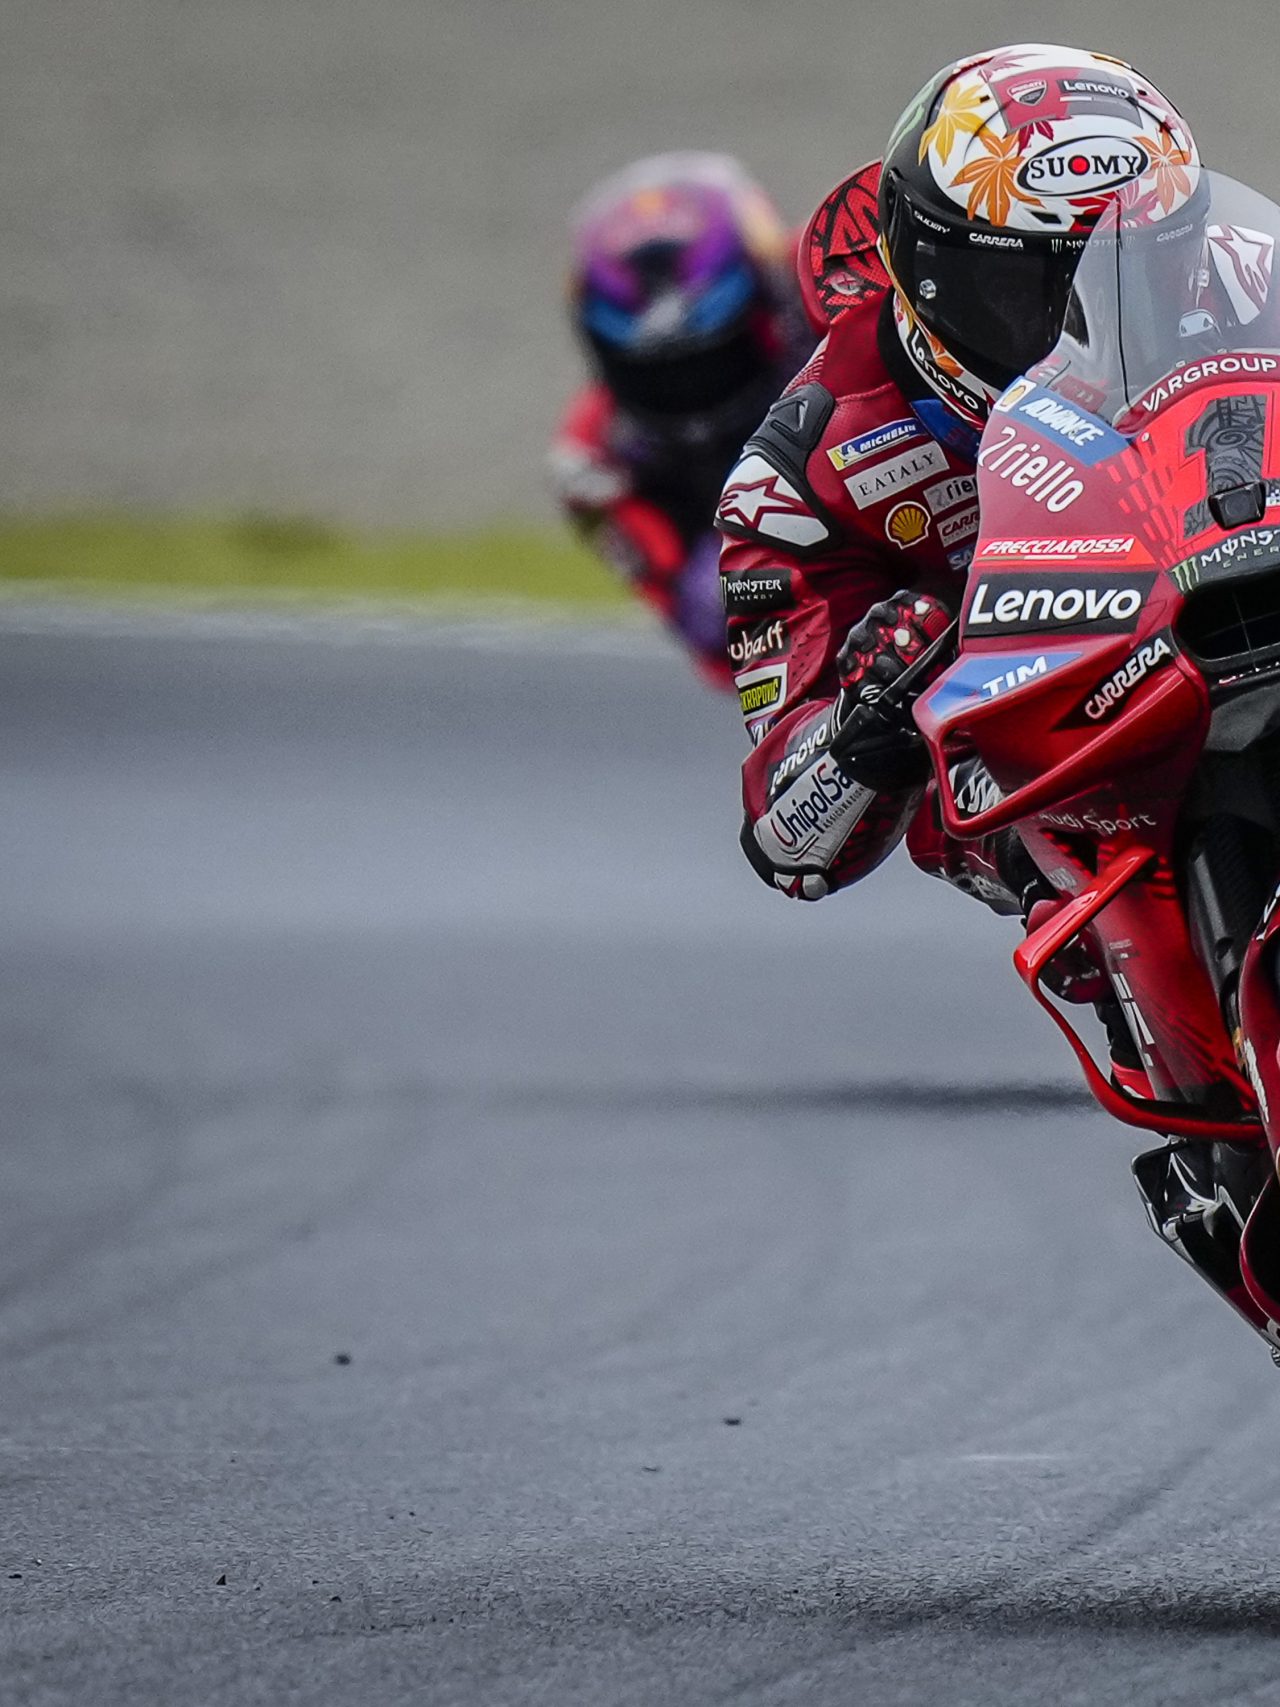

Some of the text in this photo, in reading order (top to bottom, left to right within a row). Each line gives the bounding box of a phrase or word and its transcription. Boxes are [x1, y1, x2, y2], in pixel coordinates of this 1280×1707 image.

[1063, 80, 1129, 98] Lenovo
[1030, 154, 1140, 180] SUOMY
[969, 232, 1024, 248] CARRERA
[911, 329, 979, 409] Lenovo
[859, 423, 916, 453] MICHELIN
[857, 452, 934, 496] EATALY
[941, 510, 979, 537] CARR
[981, 538, 1135, 555] FRECCIAROSSA
[727, 579, 782, 595] MONSTER
[967, 584, 1143, 625] Lenovo
[979, 656, 1048, 700] TIM
[1084, 637, 1171, 721] CARRERA
[770, 762, 854, 847] UnipolSa
